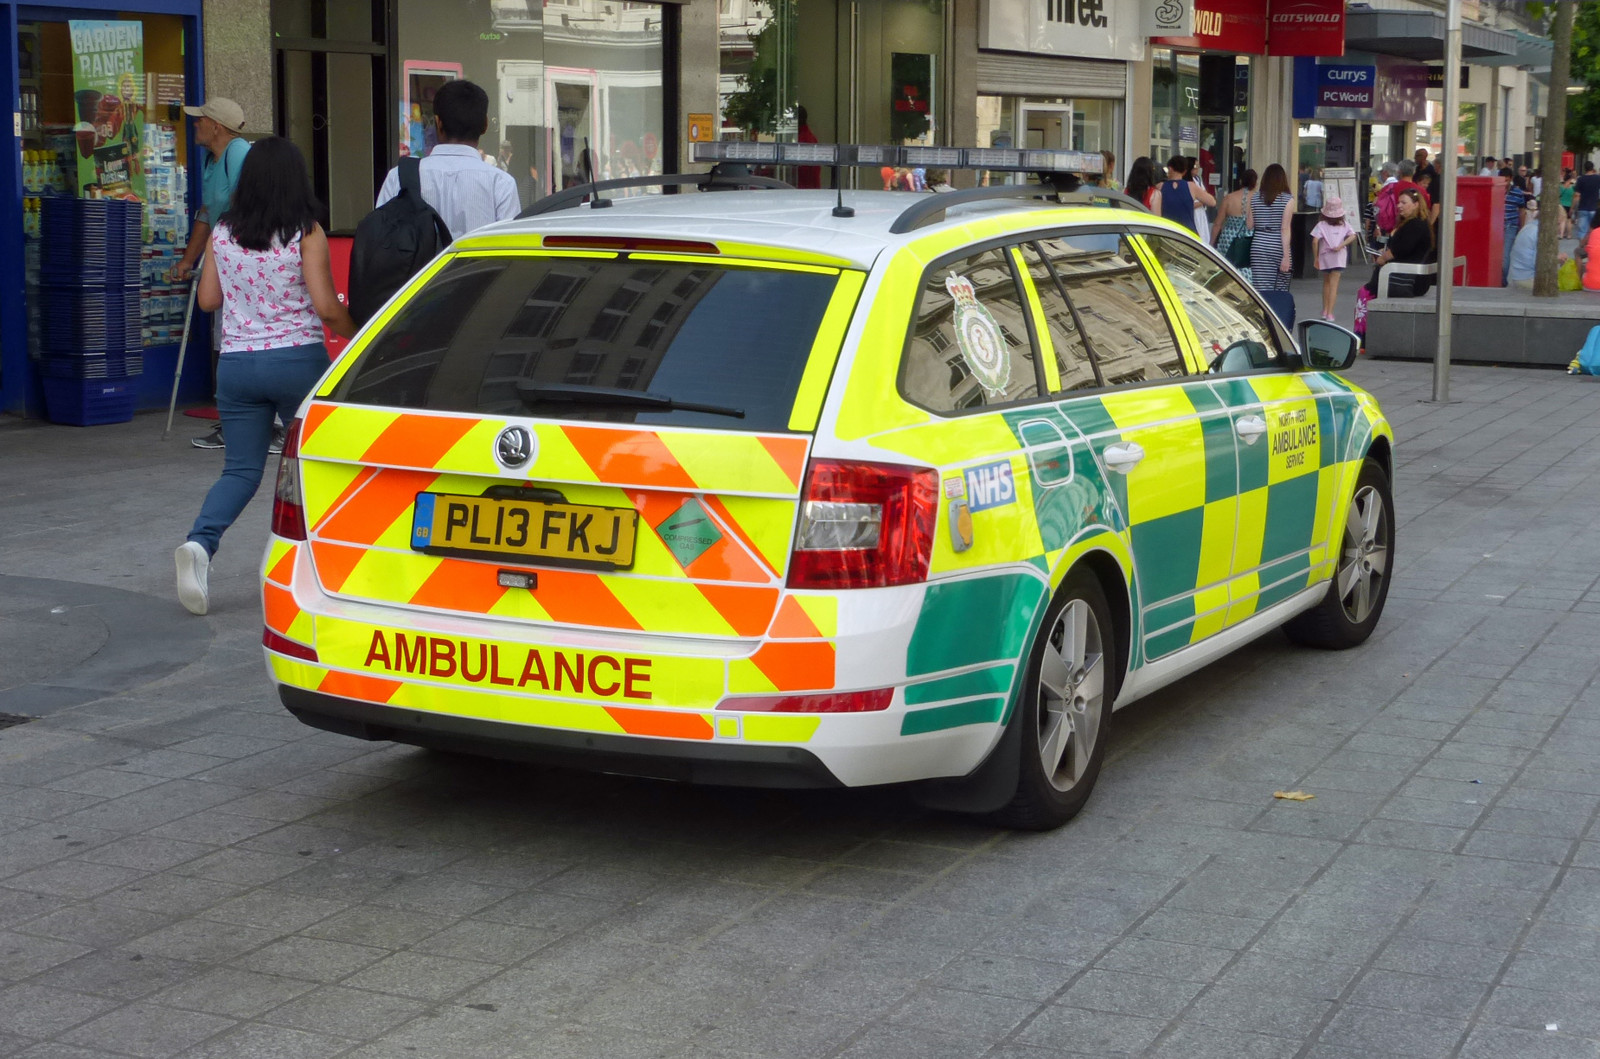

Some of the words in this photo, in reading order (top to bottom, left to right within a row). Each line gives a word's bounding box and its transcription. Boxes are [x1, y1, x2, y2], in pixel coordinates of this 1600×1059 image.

[1272, 13, 1341, 23] COTSWOLD
[73, 25, 139, 54] GARDEN
[80, 50, 135, 78] RANGE
[1323, 91, 1338, 102] PC
[1339, 92, 1369, 103] World
[1272, 423, 1316, 456] AMBULANCE
[1285, 451, 1305, 469] SERVICE
[967, 462, 1013, 508] NHS
[416, 526, 429, 538] GB
[445, 502, 530, 547] PL13
[540, 510, 621, 555] FKJ
[663, 533, 713, 545] COMPRESSED
[679, 542, 695, 550] GAS
[363, 629, 653, 700] AMBULANCE
